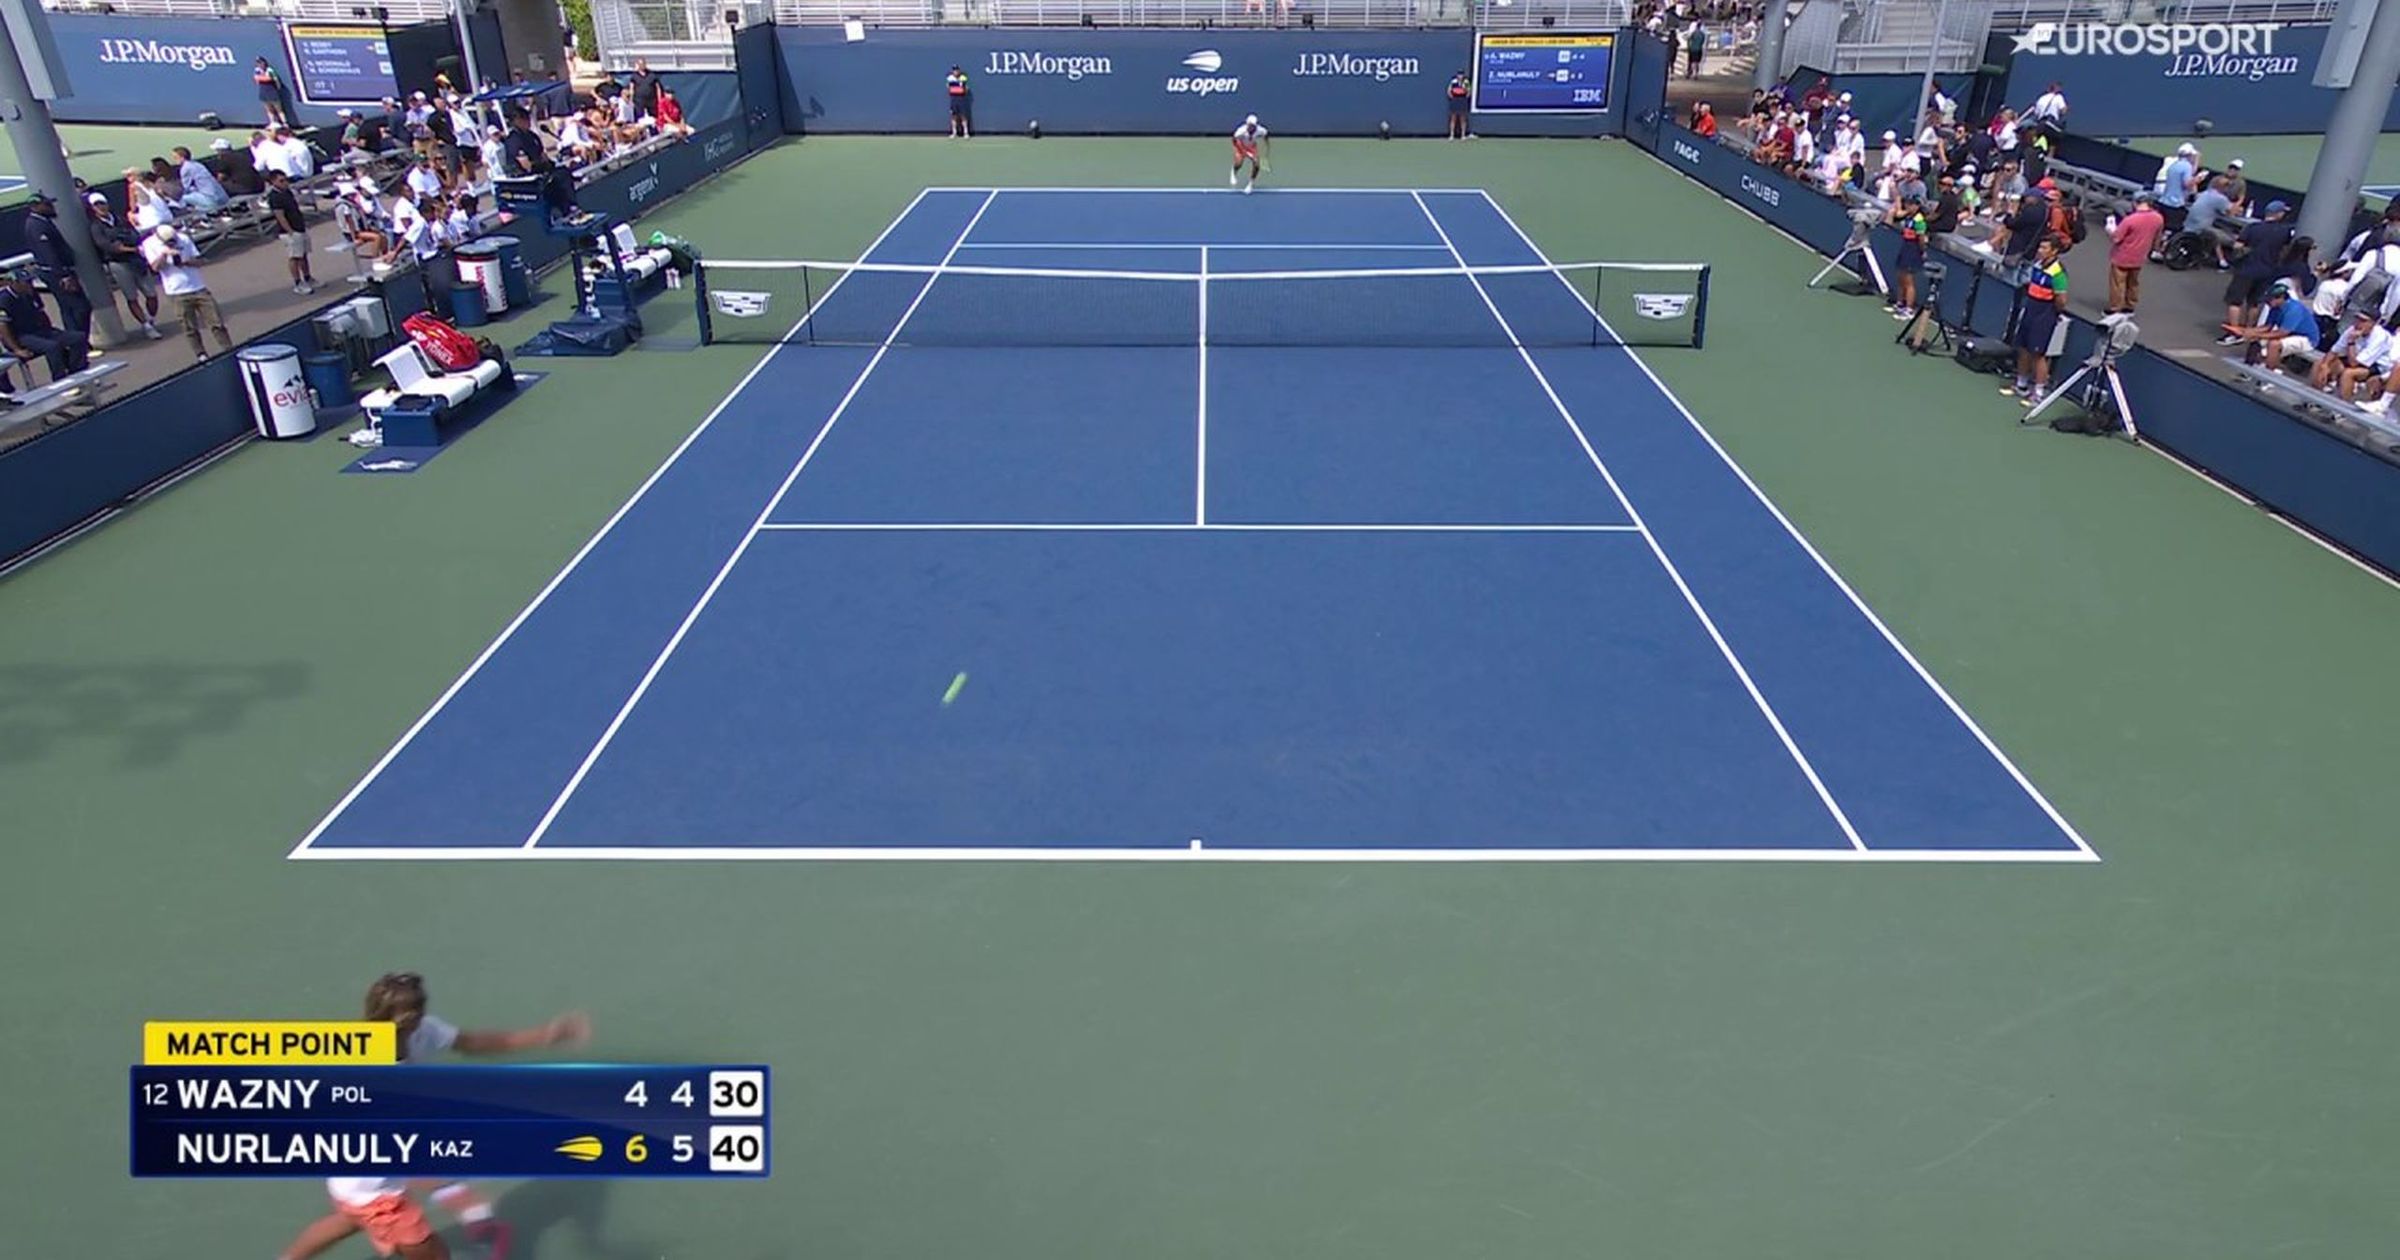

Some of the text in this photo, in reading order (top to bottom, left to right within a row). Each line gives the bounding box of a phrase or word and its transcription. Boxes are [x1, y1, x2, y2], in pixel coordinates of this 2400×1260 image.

[100, 39, 236, 71] J.P.Morgan
[985, 52, 1112, 80] J.P.Morgan
[1293, 53, 1419, 81] J.P.Morgan
[2164, 54, 2299, 81] J.P.Morgan
[1573, 88, 1602, 103] IBM
[1741, 174, 1780, 207] CHUBB
